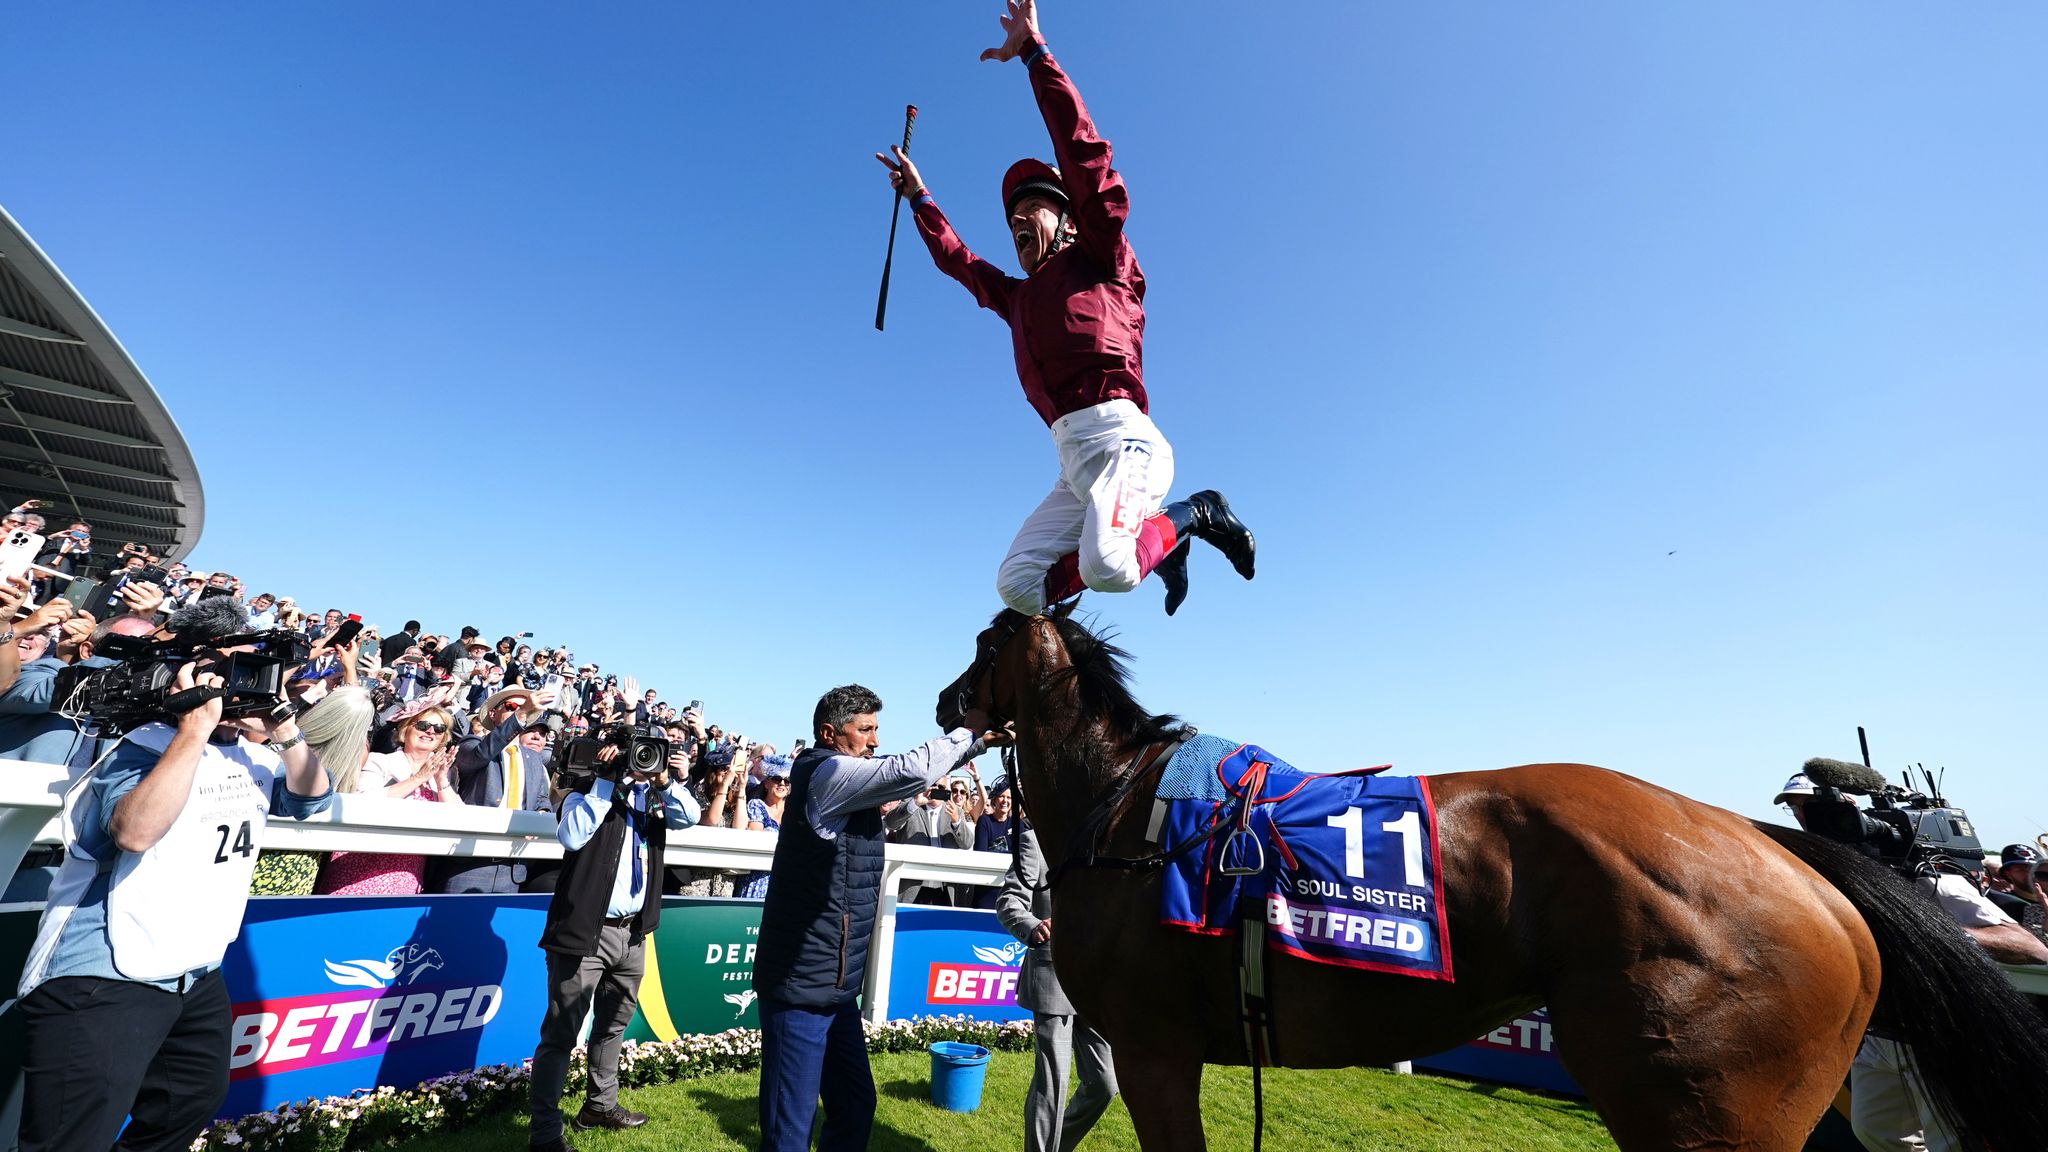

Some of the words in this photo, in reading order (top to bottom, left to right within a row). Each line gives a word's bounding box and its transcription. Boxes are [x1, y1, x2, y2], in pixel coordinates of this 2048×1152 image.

[214, 820, 254, 865] 24
[1327, 806, 1425, 888] 11
[1297, 879, 1348, 899] SOUL
[1352, 886, 1427, 913] SISTER
[746, 926, 760, 936] TH
[1266, 898, 1424, 952] BETFRED
[705, 943, 757, 964] DER
[722, 971, 753, 981] FESTI
[933, 969, 1019, 1000] BETF
[230, 984, 503, 1069] BETFRED
